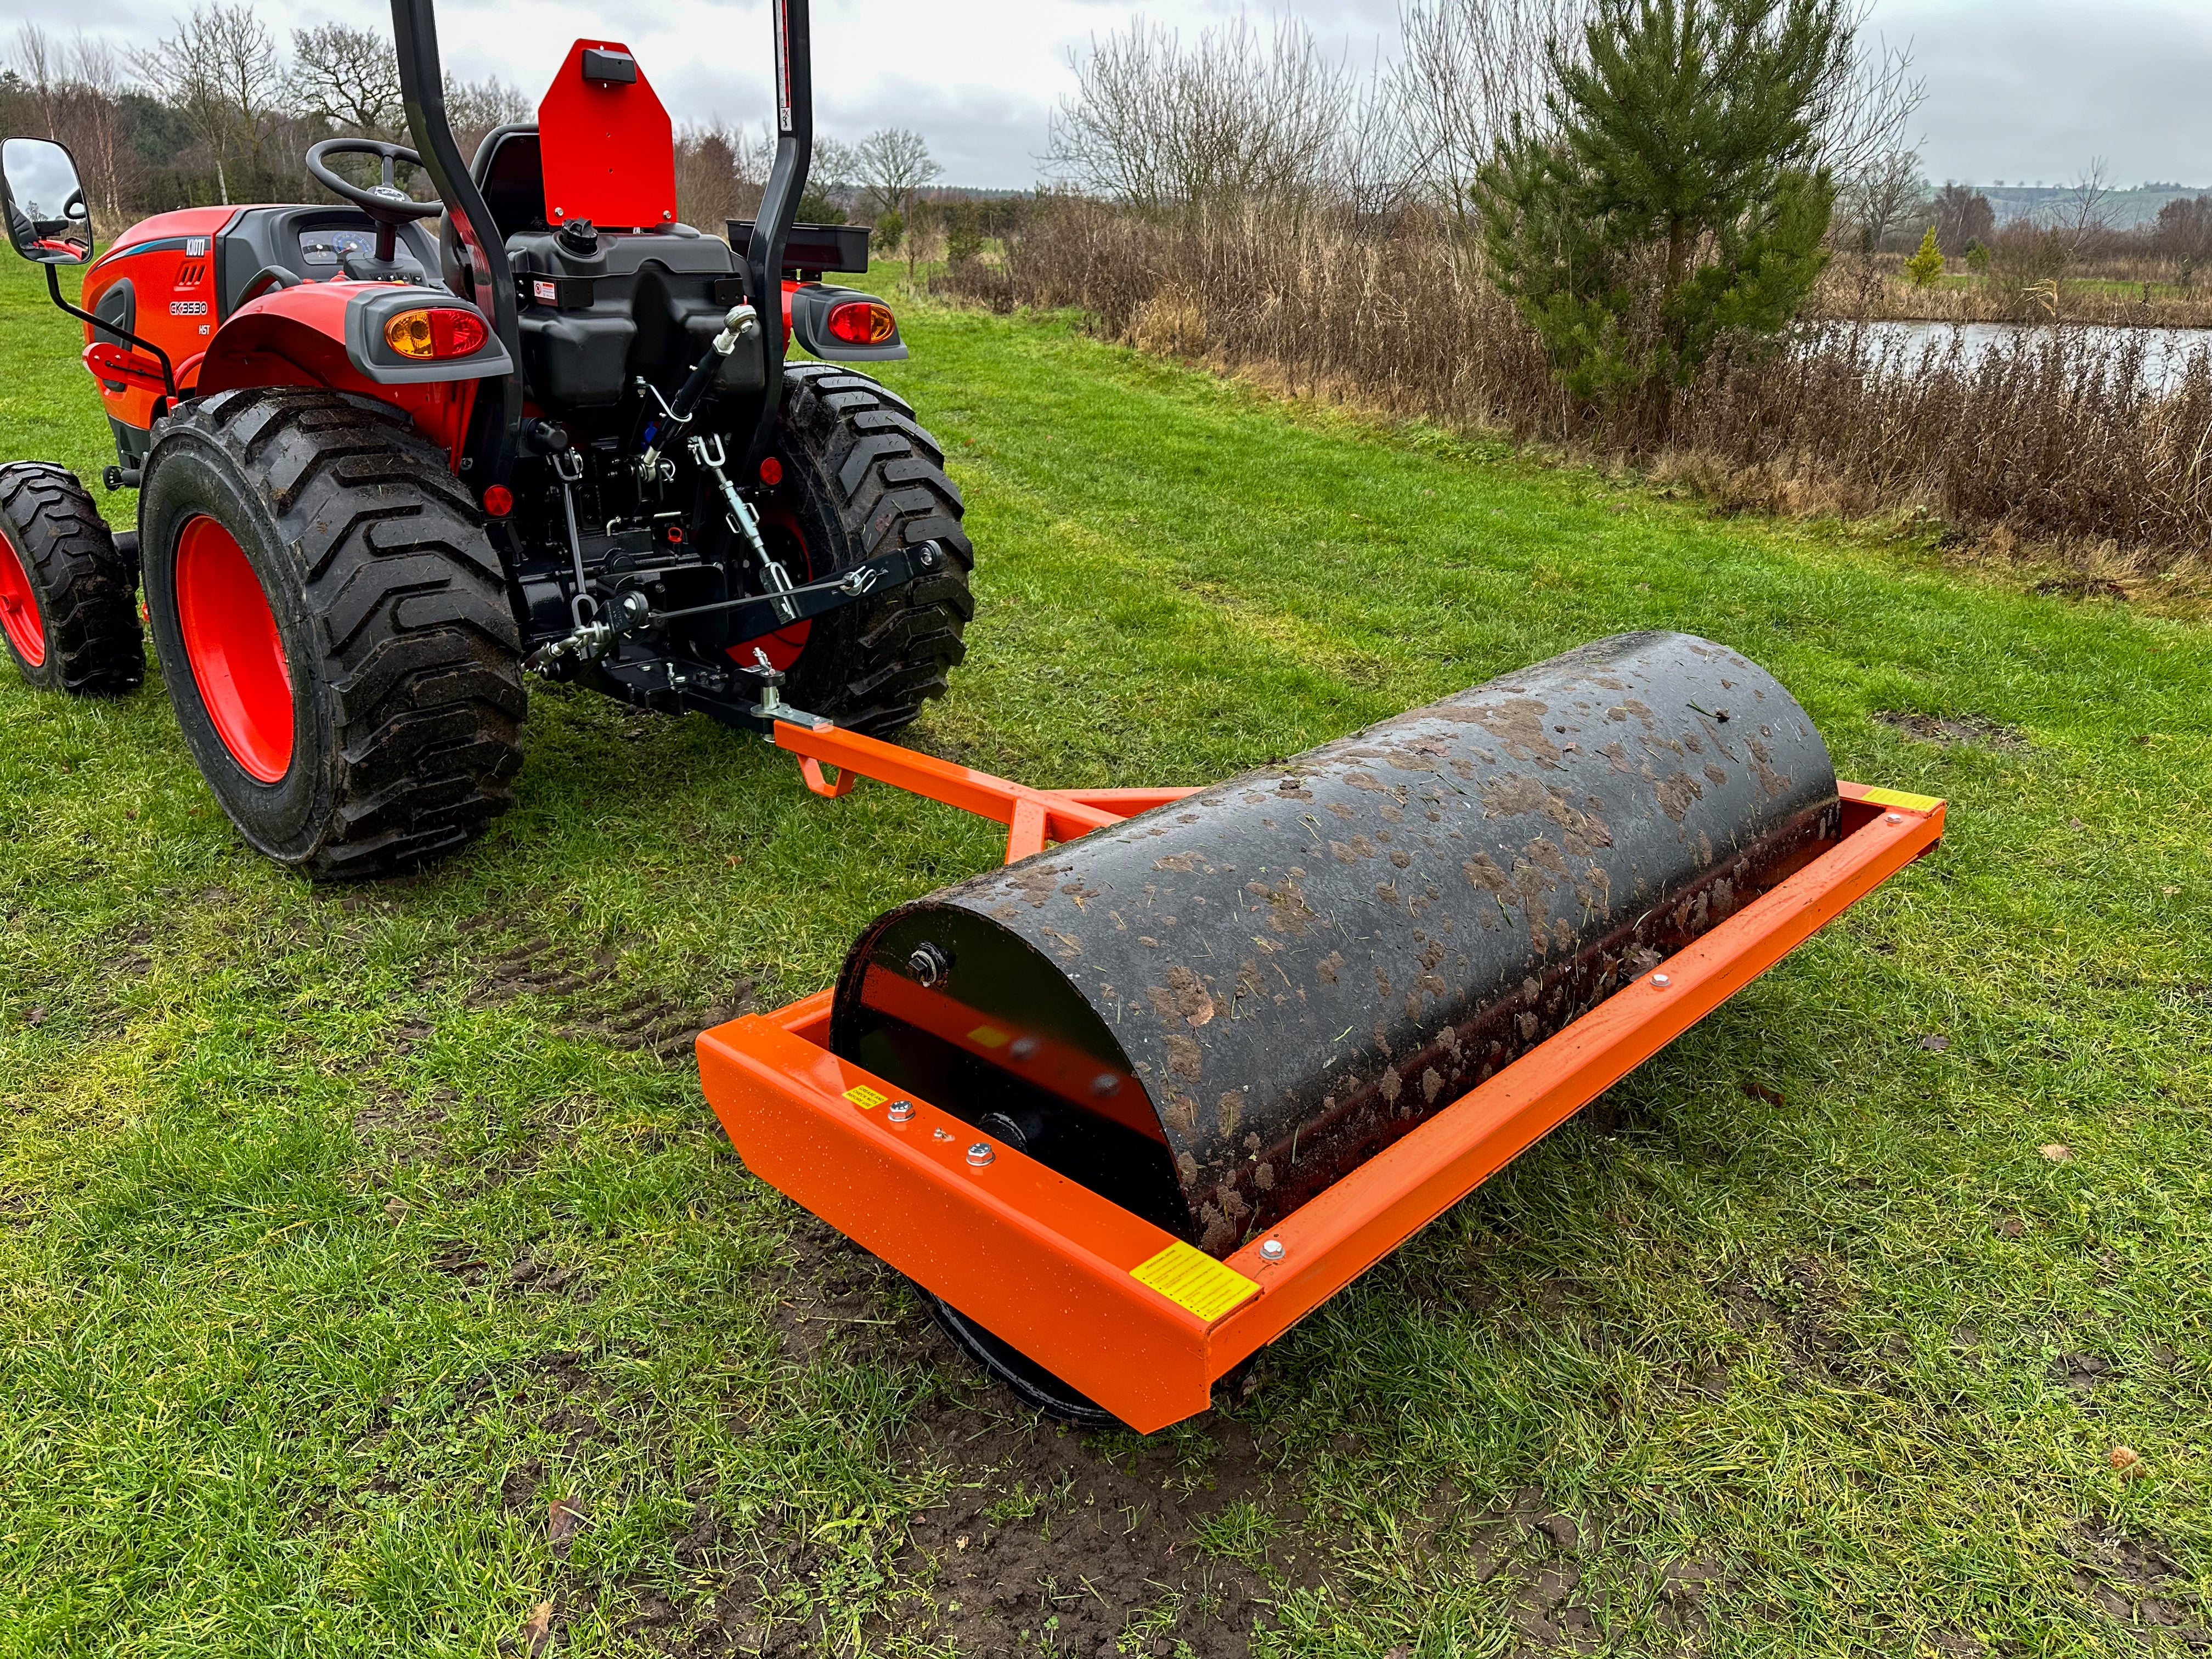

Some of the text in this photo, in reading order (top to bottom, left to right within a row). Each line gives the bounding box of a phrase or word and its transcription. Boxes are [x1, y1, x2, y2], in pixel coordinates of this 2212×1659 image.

[186, 239, 205, 256] KIOTI
[170, 302, 207, 314] CK3530
[199, 324, 210, 335] HST
[846, 1092, 863, 1102] BEFORE
[853, 1090, 867, 1098] CHECK
[859, 1087, 876, 1097] GREASE
